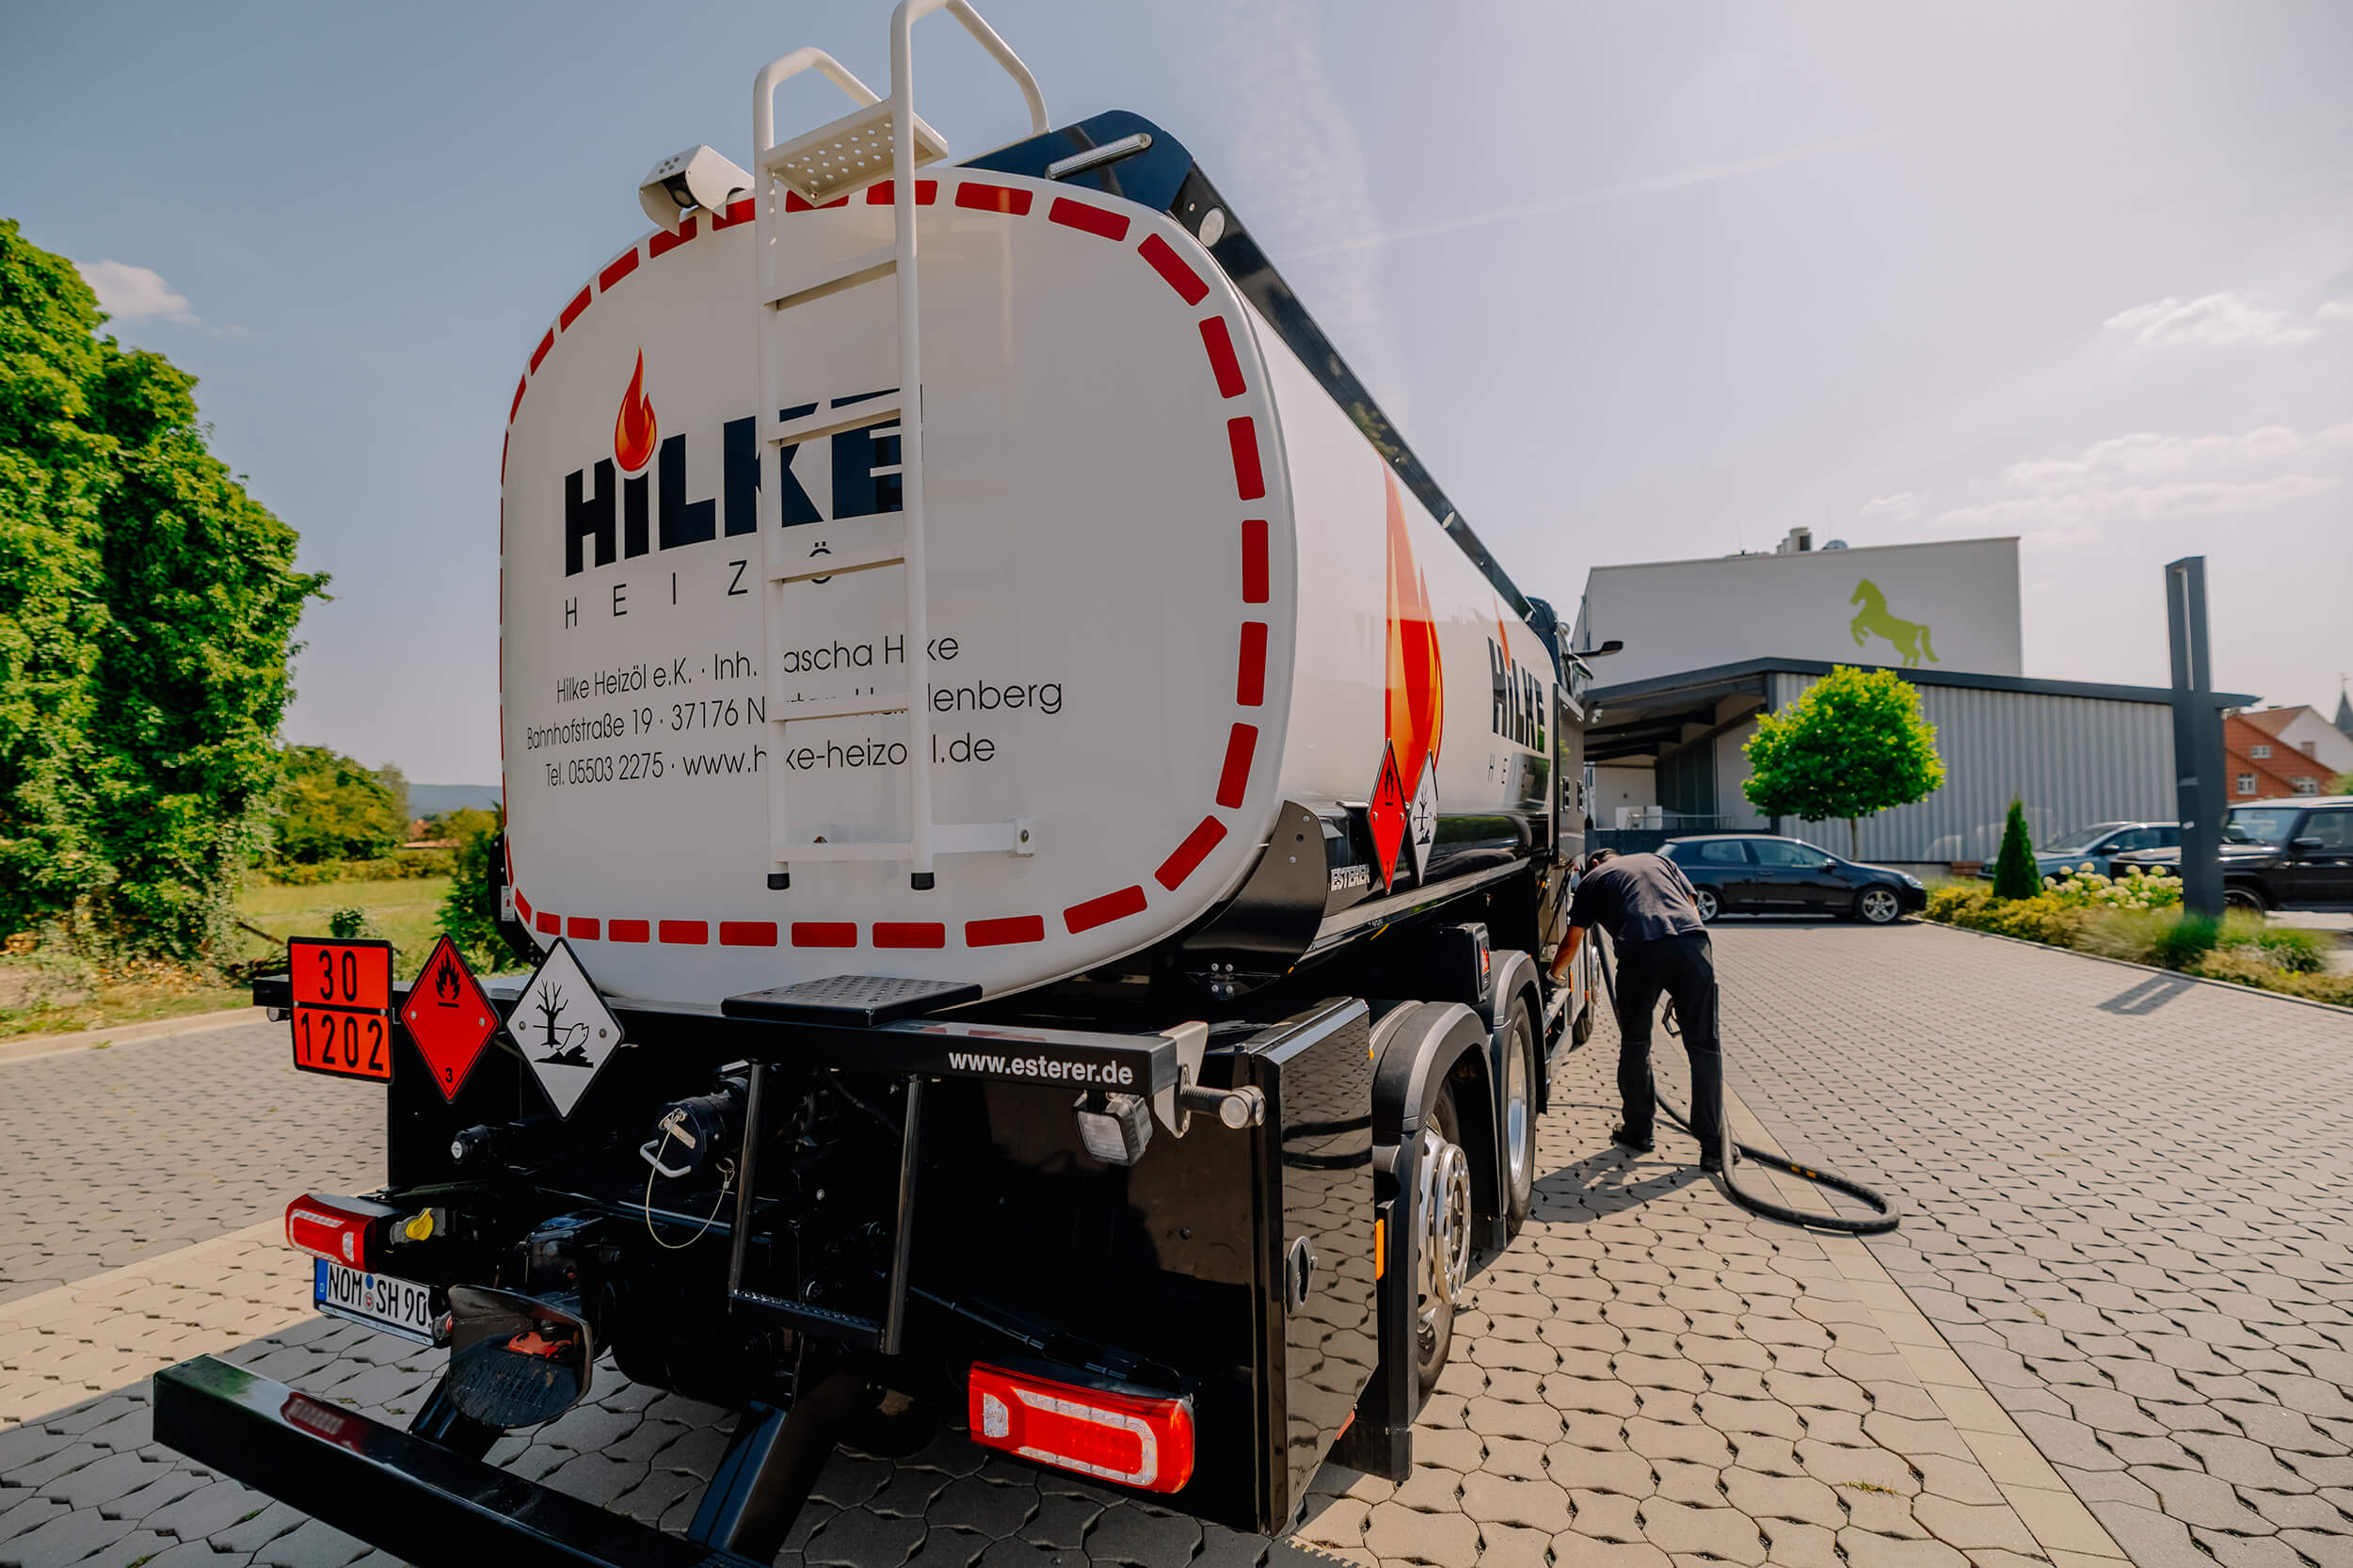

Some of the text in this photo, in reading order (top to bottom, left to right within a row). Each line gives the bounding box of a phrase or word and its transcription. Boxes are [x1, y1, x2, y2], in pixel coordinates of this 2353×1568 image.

[556, 676, 589, 703] Hilke
[594, 663, 647, 697] Heizöl
[652, 657, 692, 688] e.K.
[714, 650, 757, 680] Inh.
[784, 640, 872, 673] ascha
[527, 712, 625, 750] Bahnhofstraße
[632, 707, 653, 735] 19
[671, 698, 739, 731] 37176
[546, 761, 565, 787] Tel.
[568, 756, 613, 785] 05503
[618, 752, 664, 780] 2275
[319, 950, 357, 1001] 30
[301, 1013, 383, 1072] 1202
[948, 1051, 1134, 1084] www.esterer.de
[445, 1067, 454, 1083] 3
[328, 1264, 362, 1307] NOM
[376, 1279, 399, 1318] SH
[405, 1288, 432, 1329] 90
